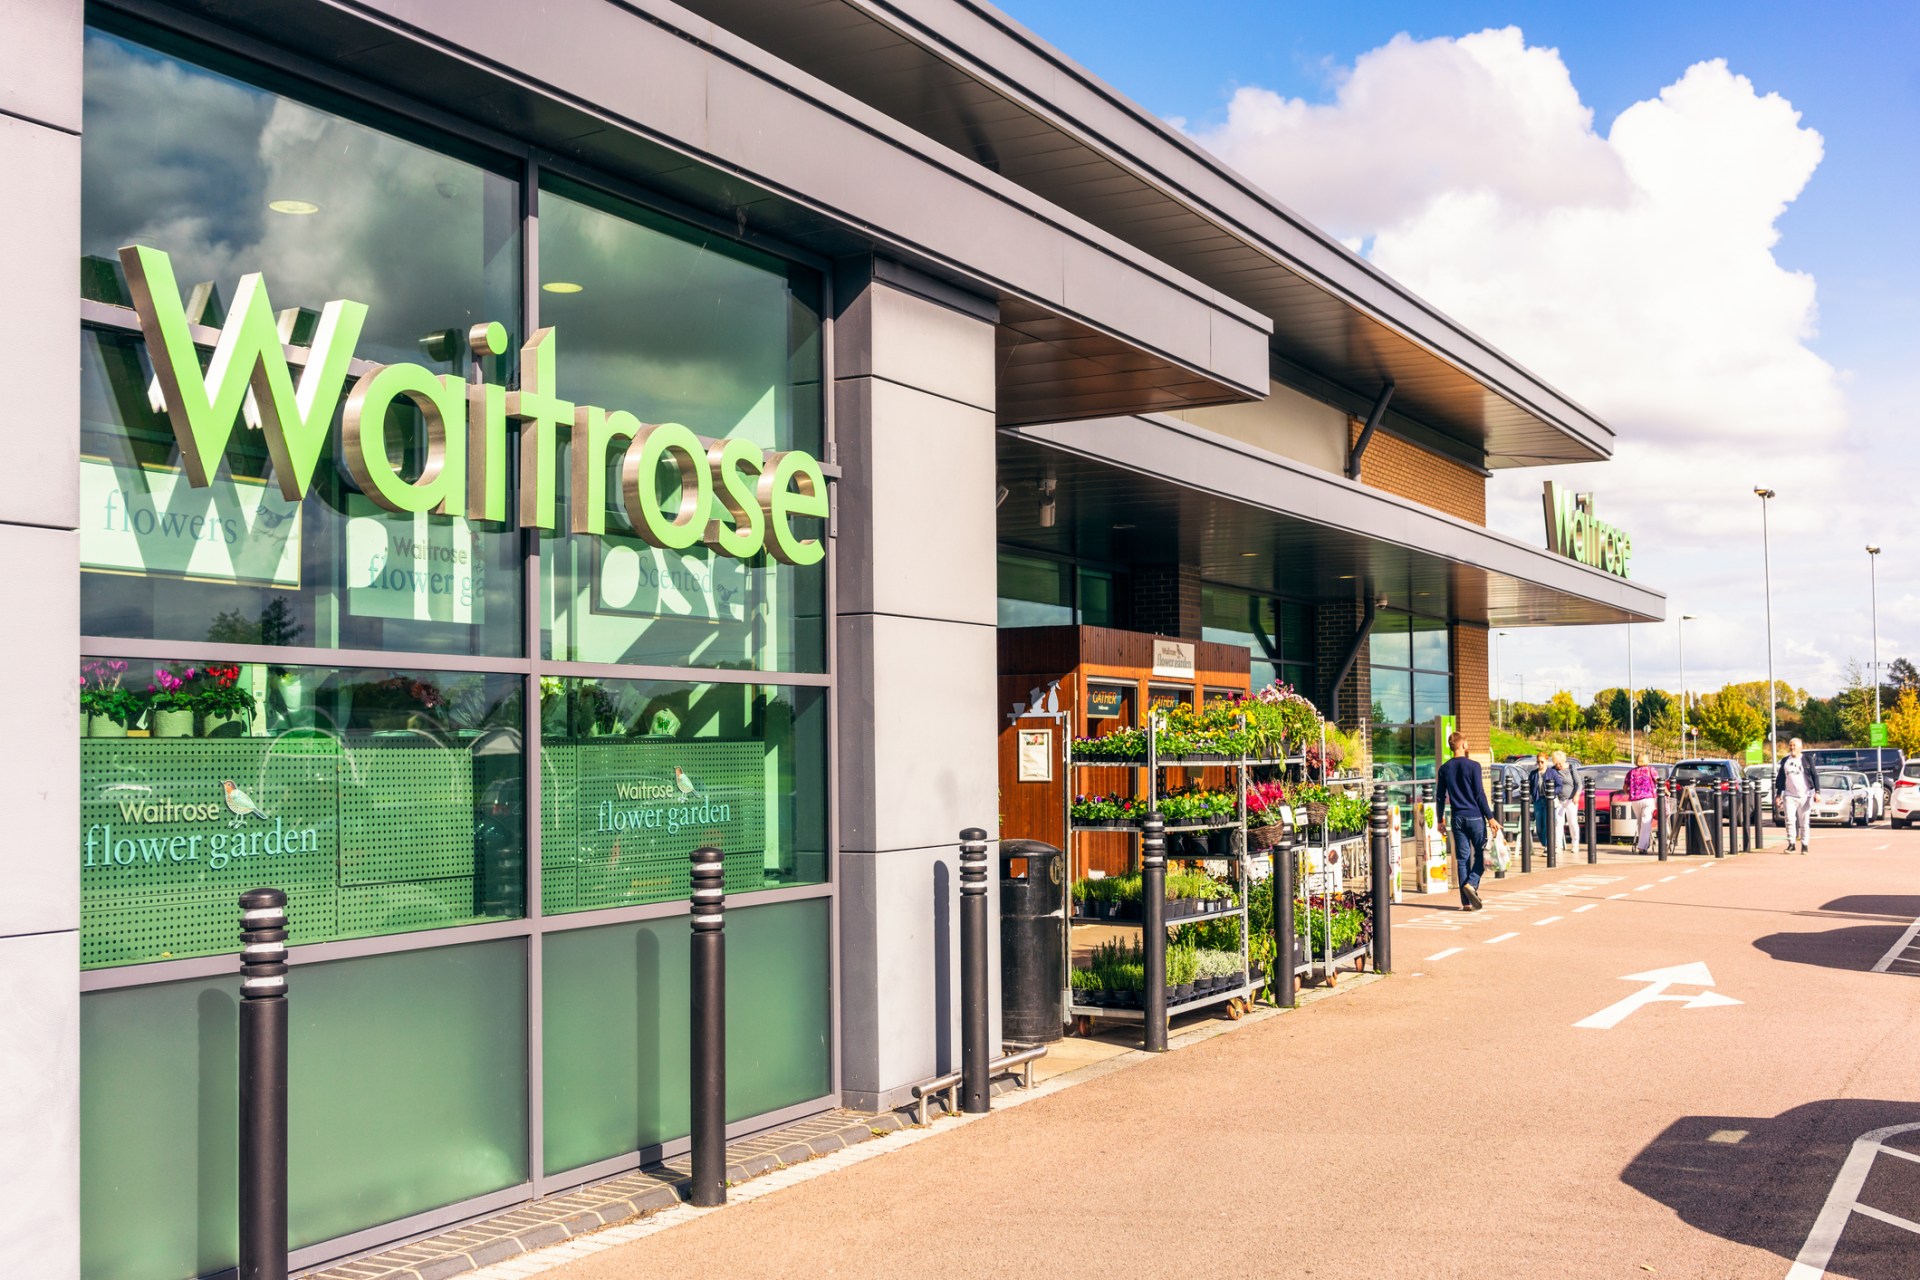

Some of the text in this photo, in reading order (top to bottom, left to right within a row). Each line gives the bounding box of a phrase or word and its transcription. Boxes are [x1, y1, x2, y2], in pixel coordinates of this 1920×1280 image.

[118, 245, 829, 566] Waitrose
[103, 488, 238, 545] flowers
[1543, 480, 1633, 579] Waitrose
[393, 536, 468, 565] Waitrose
[368, 554, 454, 595] flower
[639, 556, 713, 593] Scented
[1092, 690, 1117, 704] GATHER
[616, 781, 674, 800] Waitrose
[118, 798, 220, 824] Waitrose
[597, 795, 731, 834] flower garden
[84, 816, 319, 869] flower garden
